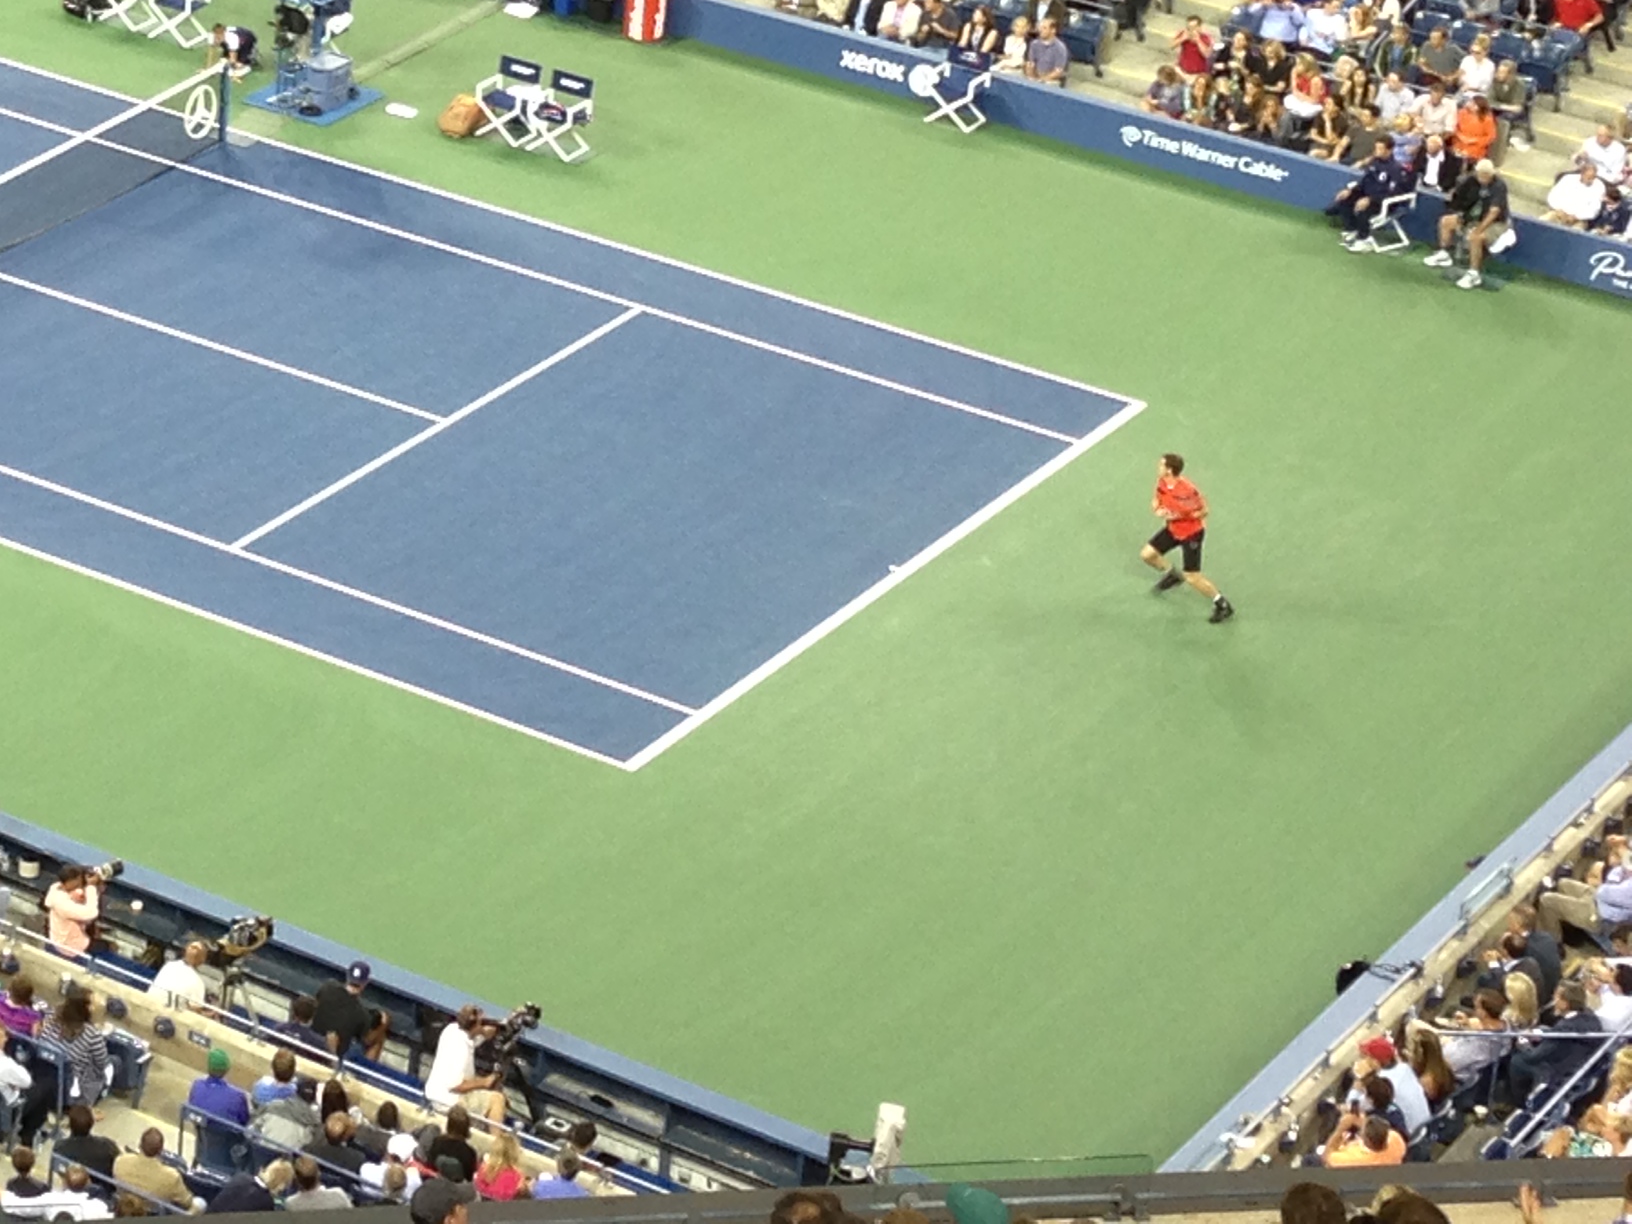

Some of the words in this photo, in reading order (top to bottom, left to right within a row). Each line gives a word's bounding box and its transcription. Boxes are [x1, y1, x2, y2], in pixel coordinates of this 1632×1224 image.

[839, 49, 905, 82] xerox
[1142, 129, 1180, 154] Time
[1180, 140, 1238, 169] Warner
